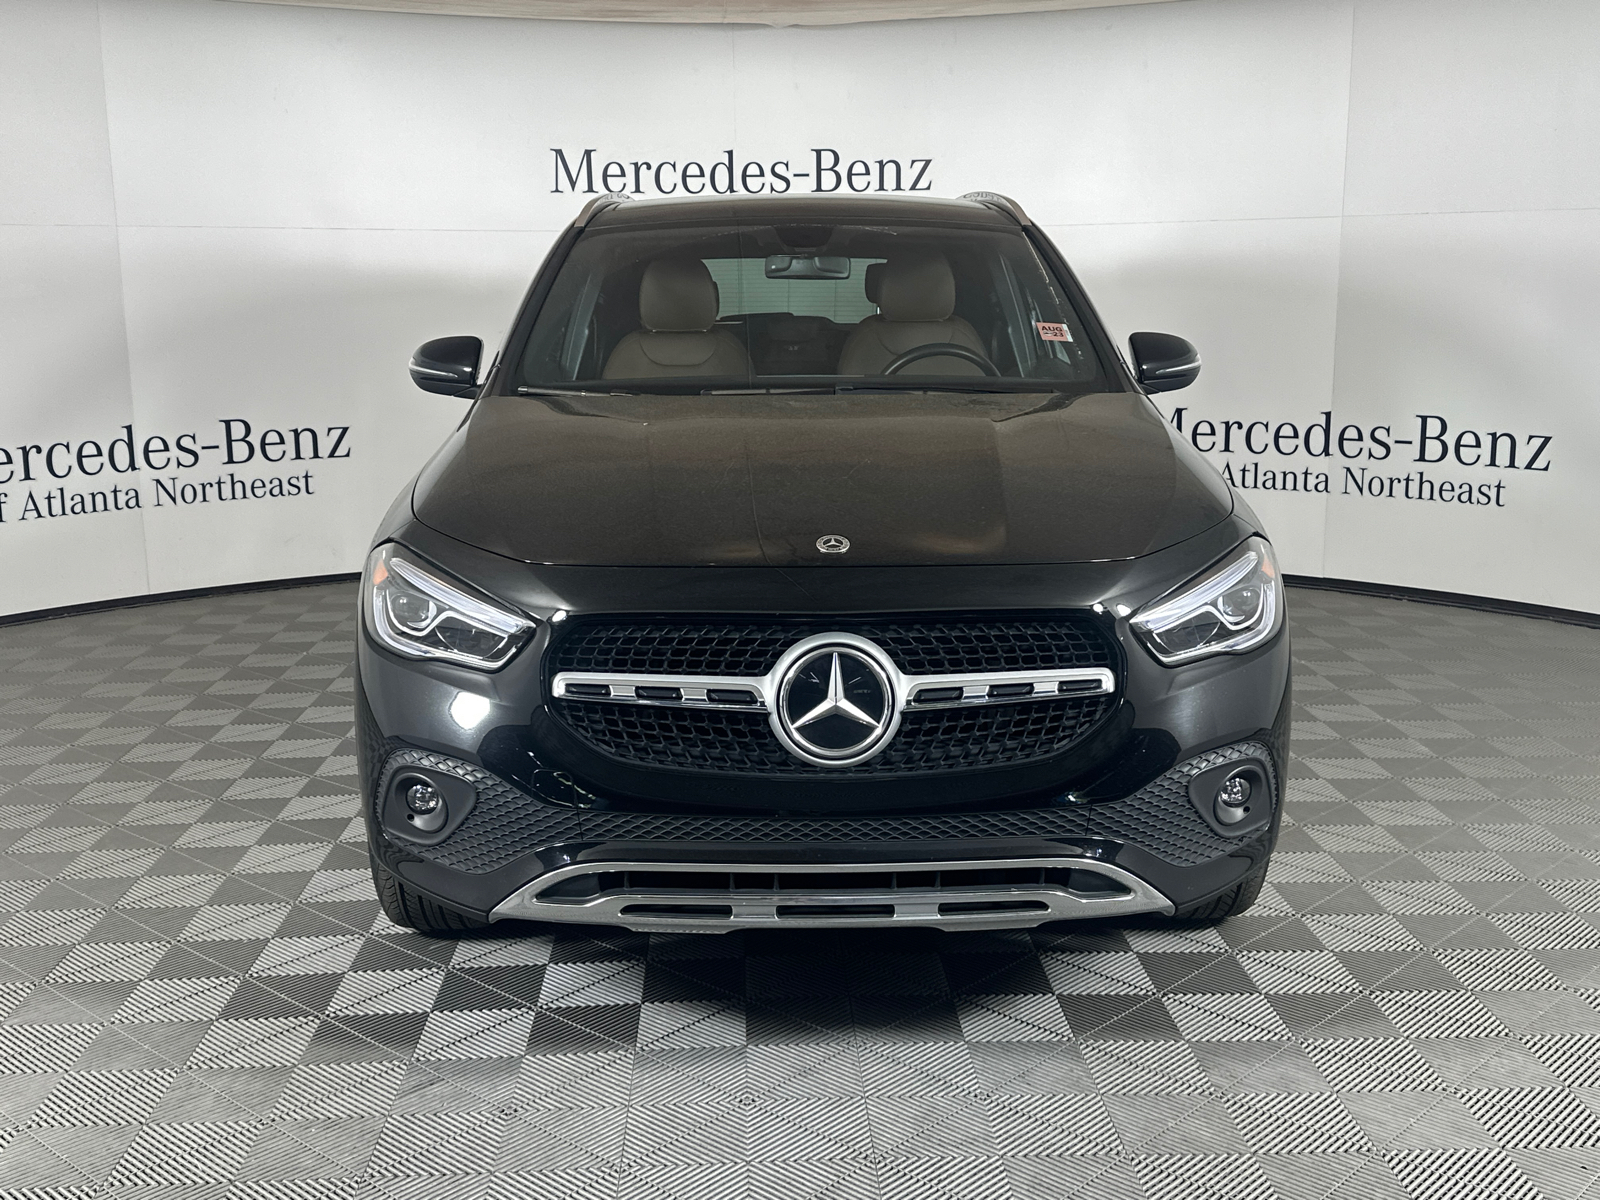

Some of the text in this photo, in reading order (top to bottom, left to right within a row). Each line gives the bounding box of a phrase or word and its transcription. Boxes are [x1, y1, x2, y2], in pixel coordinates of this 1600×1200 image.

[549, 148, 934, 194] Mercedes-Benz
[18, 487, 142, 521] Atlanta
[152, 470, 315, 507] Northeast
[1222, 460, 1506, 507] Atlanta Northeast
